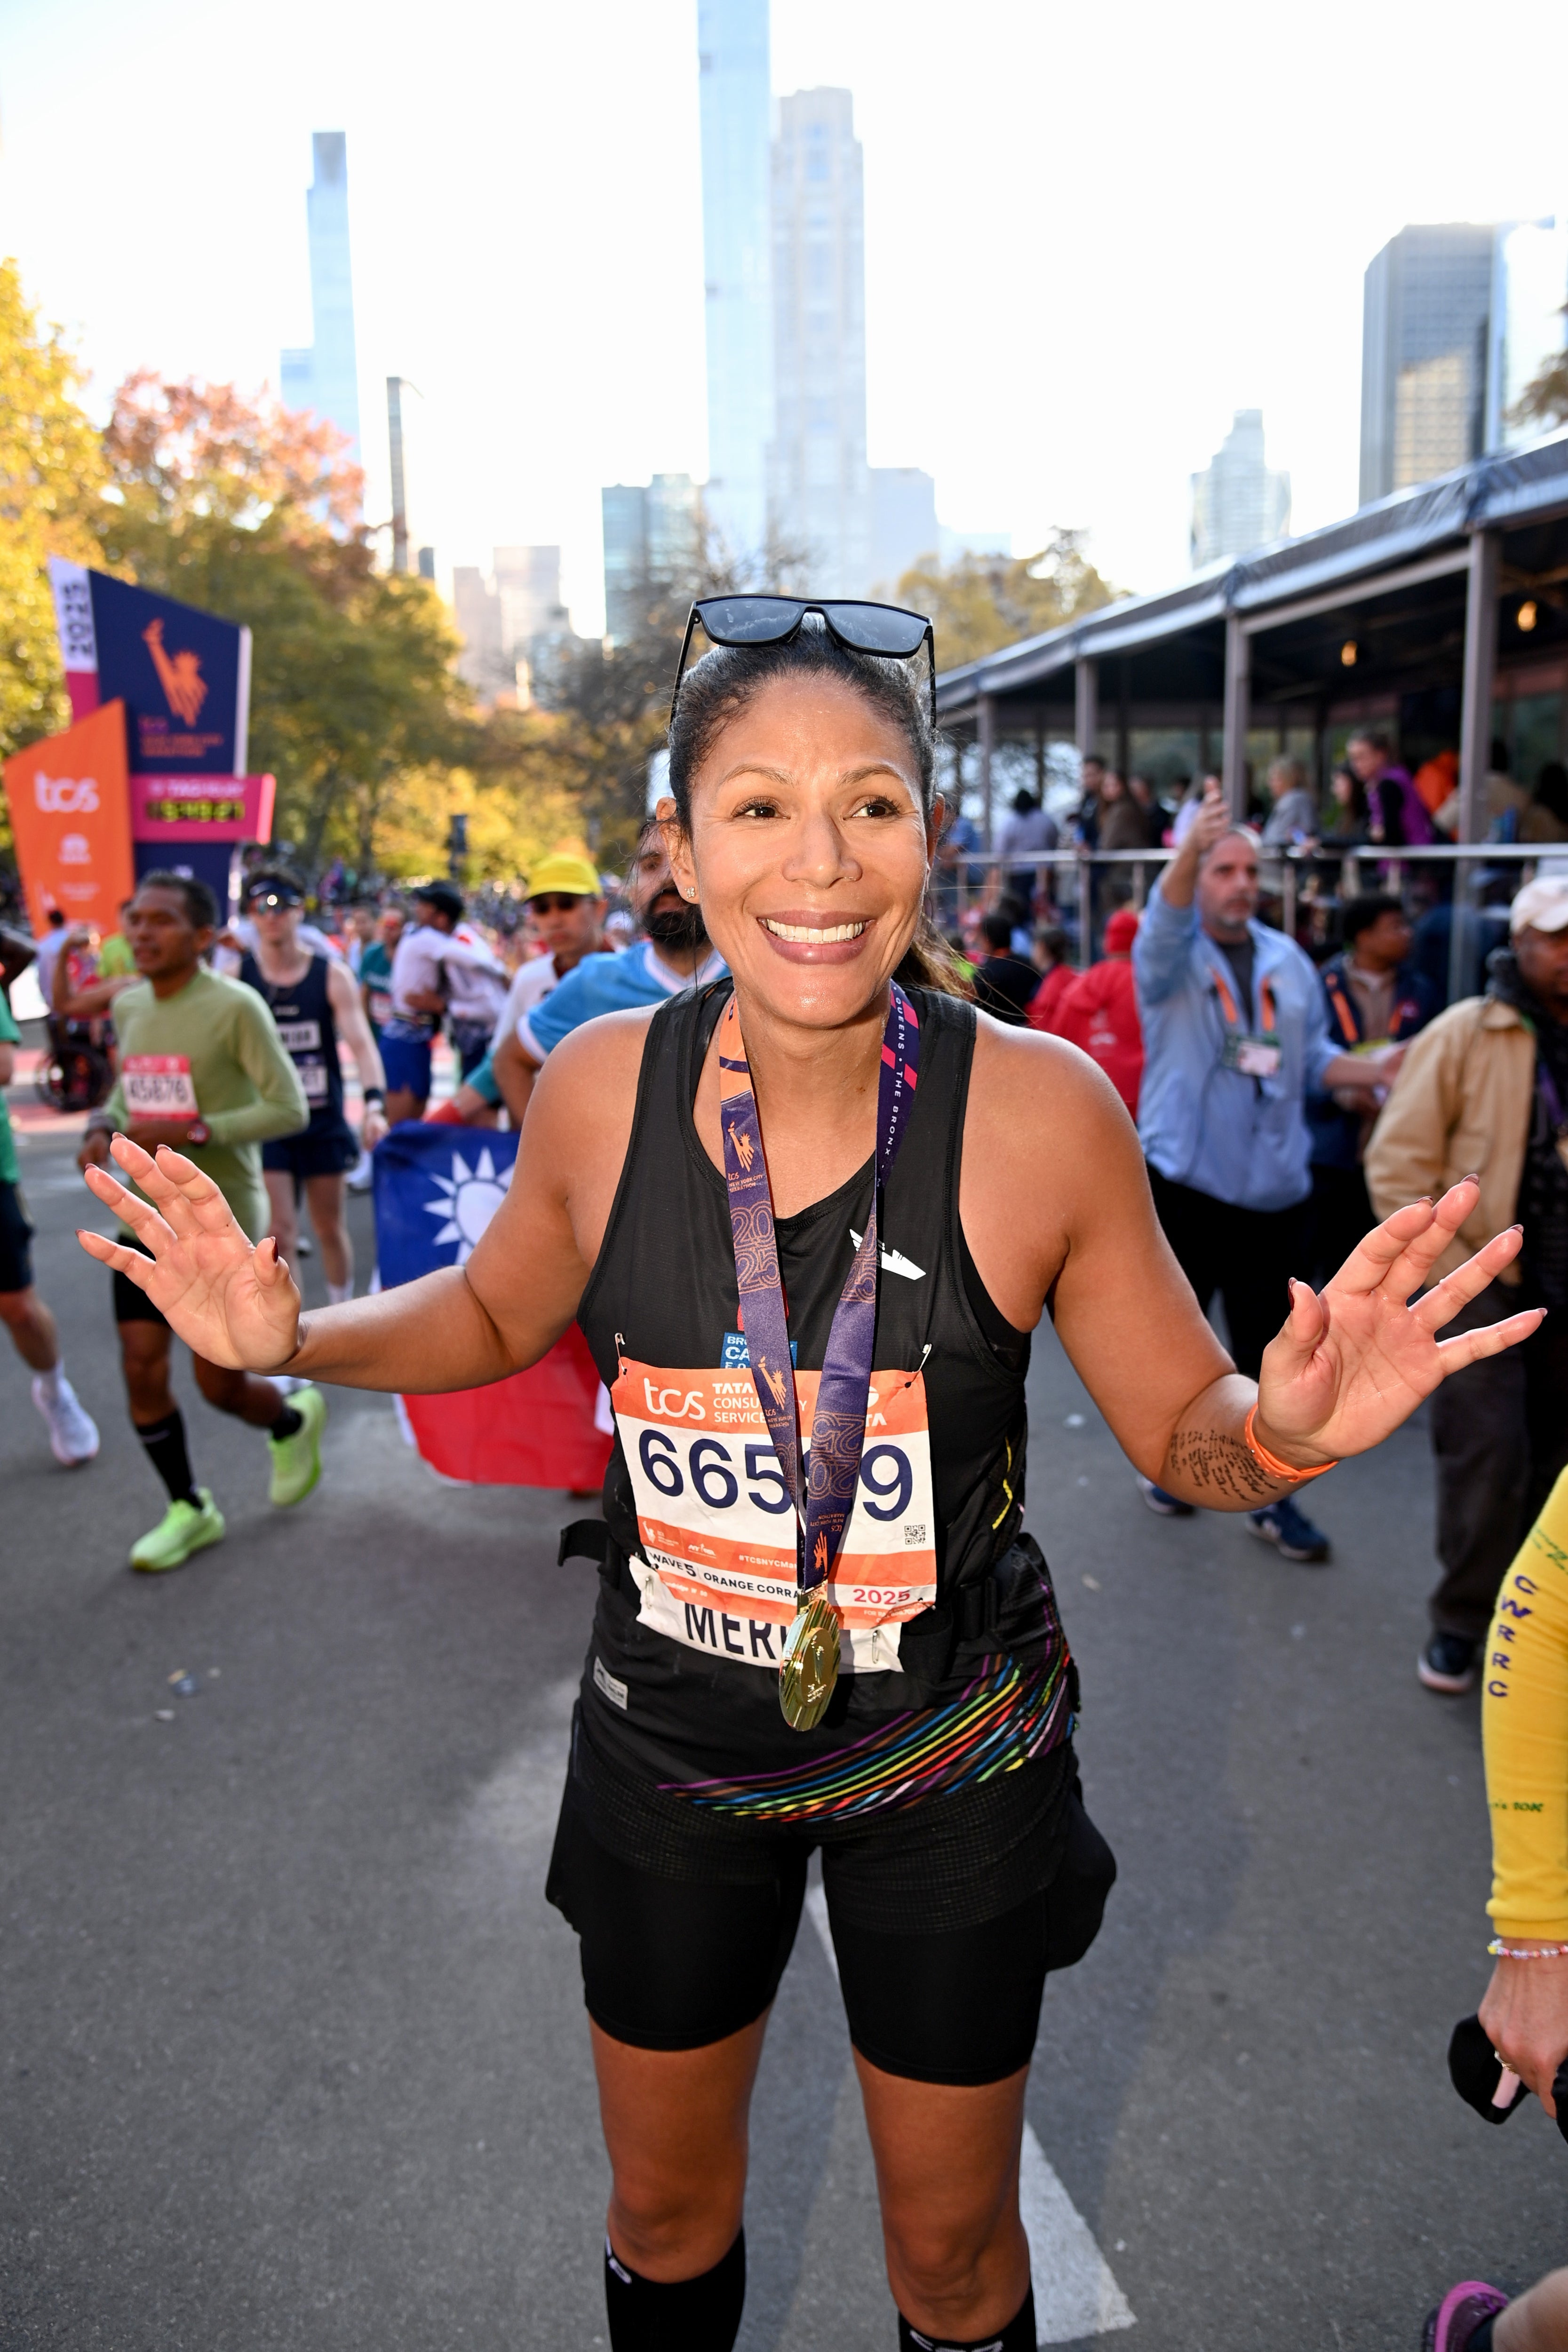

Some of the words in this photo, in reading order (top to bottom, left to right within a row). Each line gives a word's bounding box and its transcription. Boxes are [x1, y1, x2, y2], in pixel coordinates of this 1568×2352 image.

[64, 582, 92, 657] 2025
[34, 771, 99, 812] tcs
[896, 997, 905, 1049] QUEENS
[894, 1071, 903, 1097] THE
[885, 1105, 899, 1155] BRONX
[730, 1182, 756, 1192] MARATHON
[730, 1200, 776, 1250] 20
[734, 1248, 781, 1295] 25
[644, 1378, 706, 1420] tcs
[712, 1383, 754, 1394] TATA
[714, 1412, 766, 1423] SERVICE
[639, 1429, 913, 1522] 6659
[650, 1552, 683, 1570] WAVE
[685, 1564, 697, 1577] 5
[703, 1573, 754, 1591] ORANGE
[757, 1584, 798, 1599] CORRA
[739, 1554, 797, 1569] #TCSNYCMar
[853, 1589, 910, 1605] 2025
[685, 1602, 788, 1660] MER
